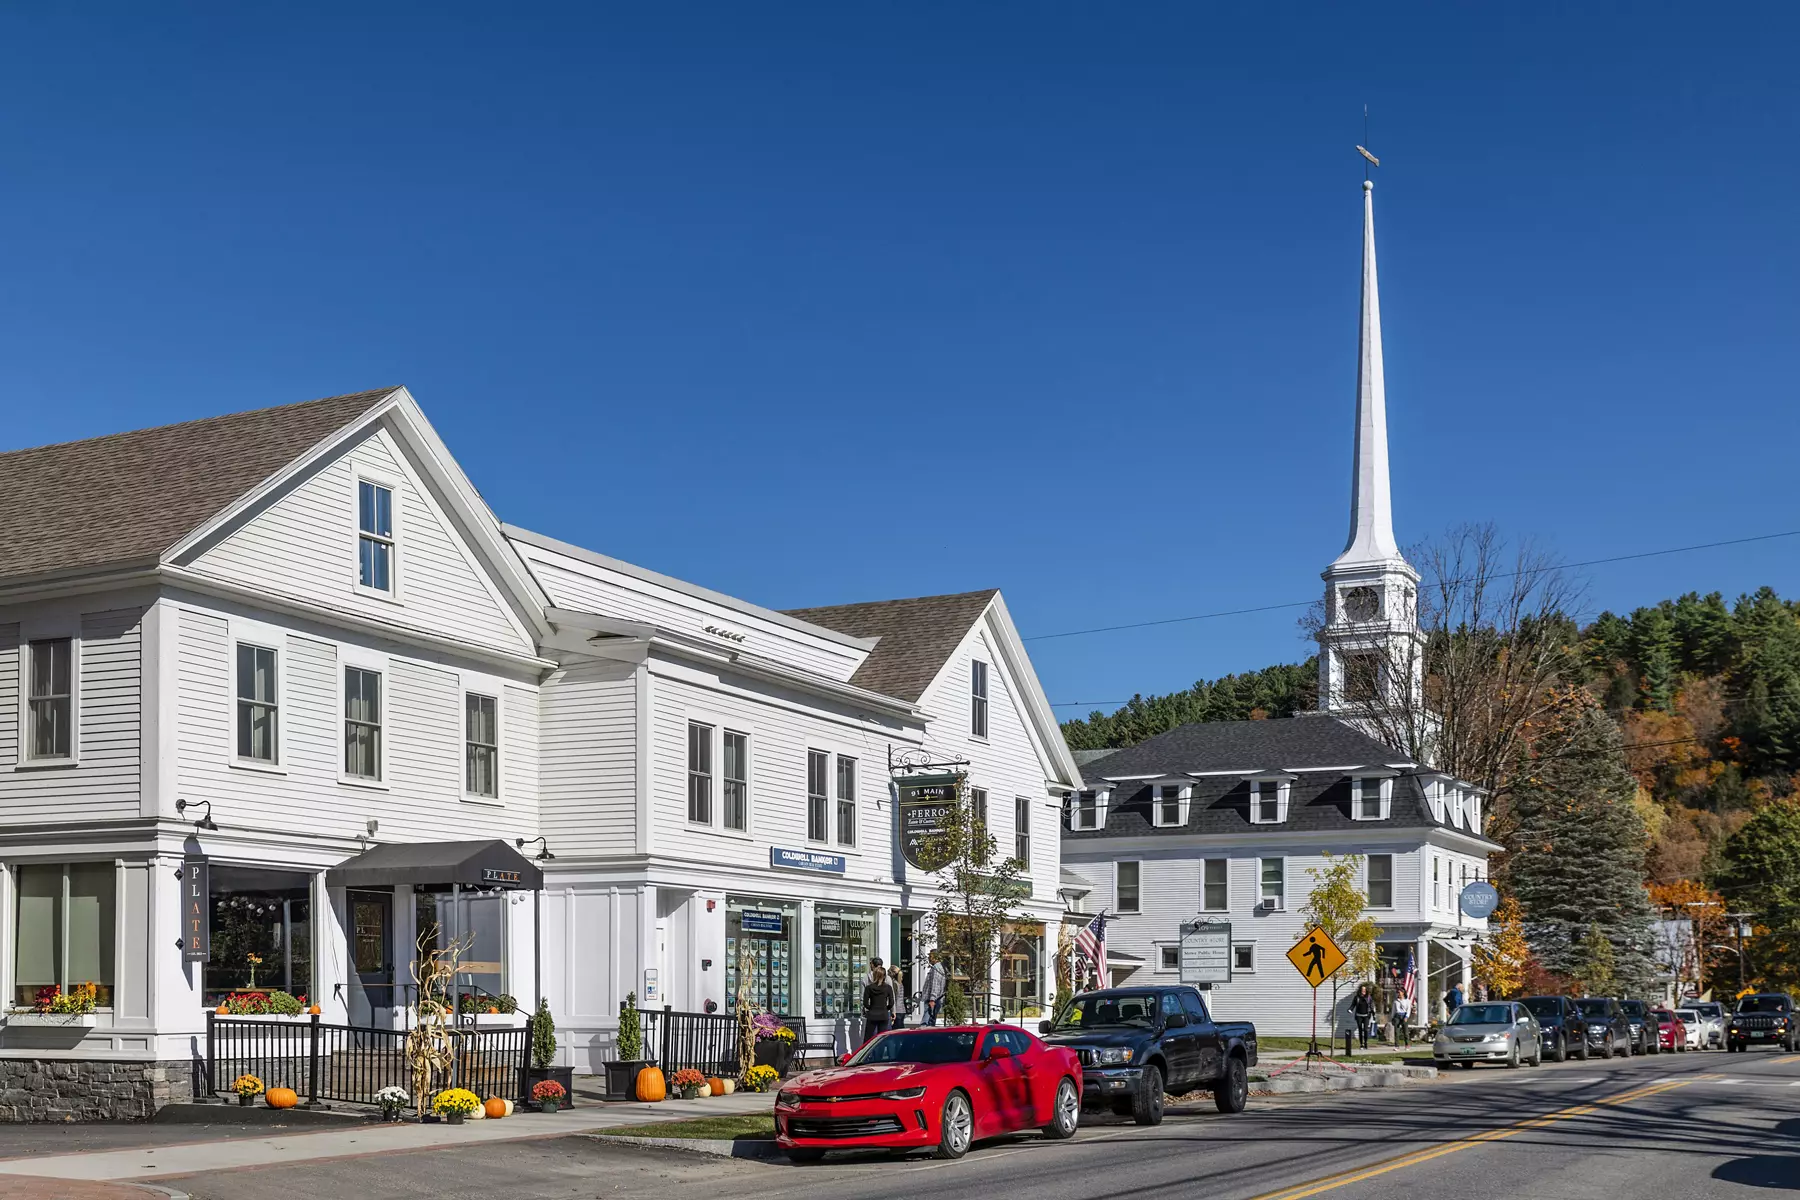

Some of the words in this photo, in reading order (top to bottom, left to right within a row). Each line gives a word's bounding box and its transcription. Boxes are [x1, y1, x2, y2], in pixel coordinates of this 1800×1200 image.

[911, 808, 946, 818] FERRO
[781, 851, 810, 862] COLDWELL
[811, 854, 833, 865] BANKER
[486, 870, 519, 881] PLATE
[191, 866, 201, 949] PLATE
